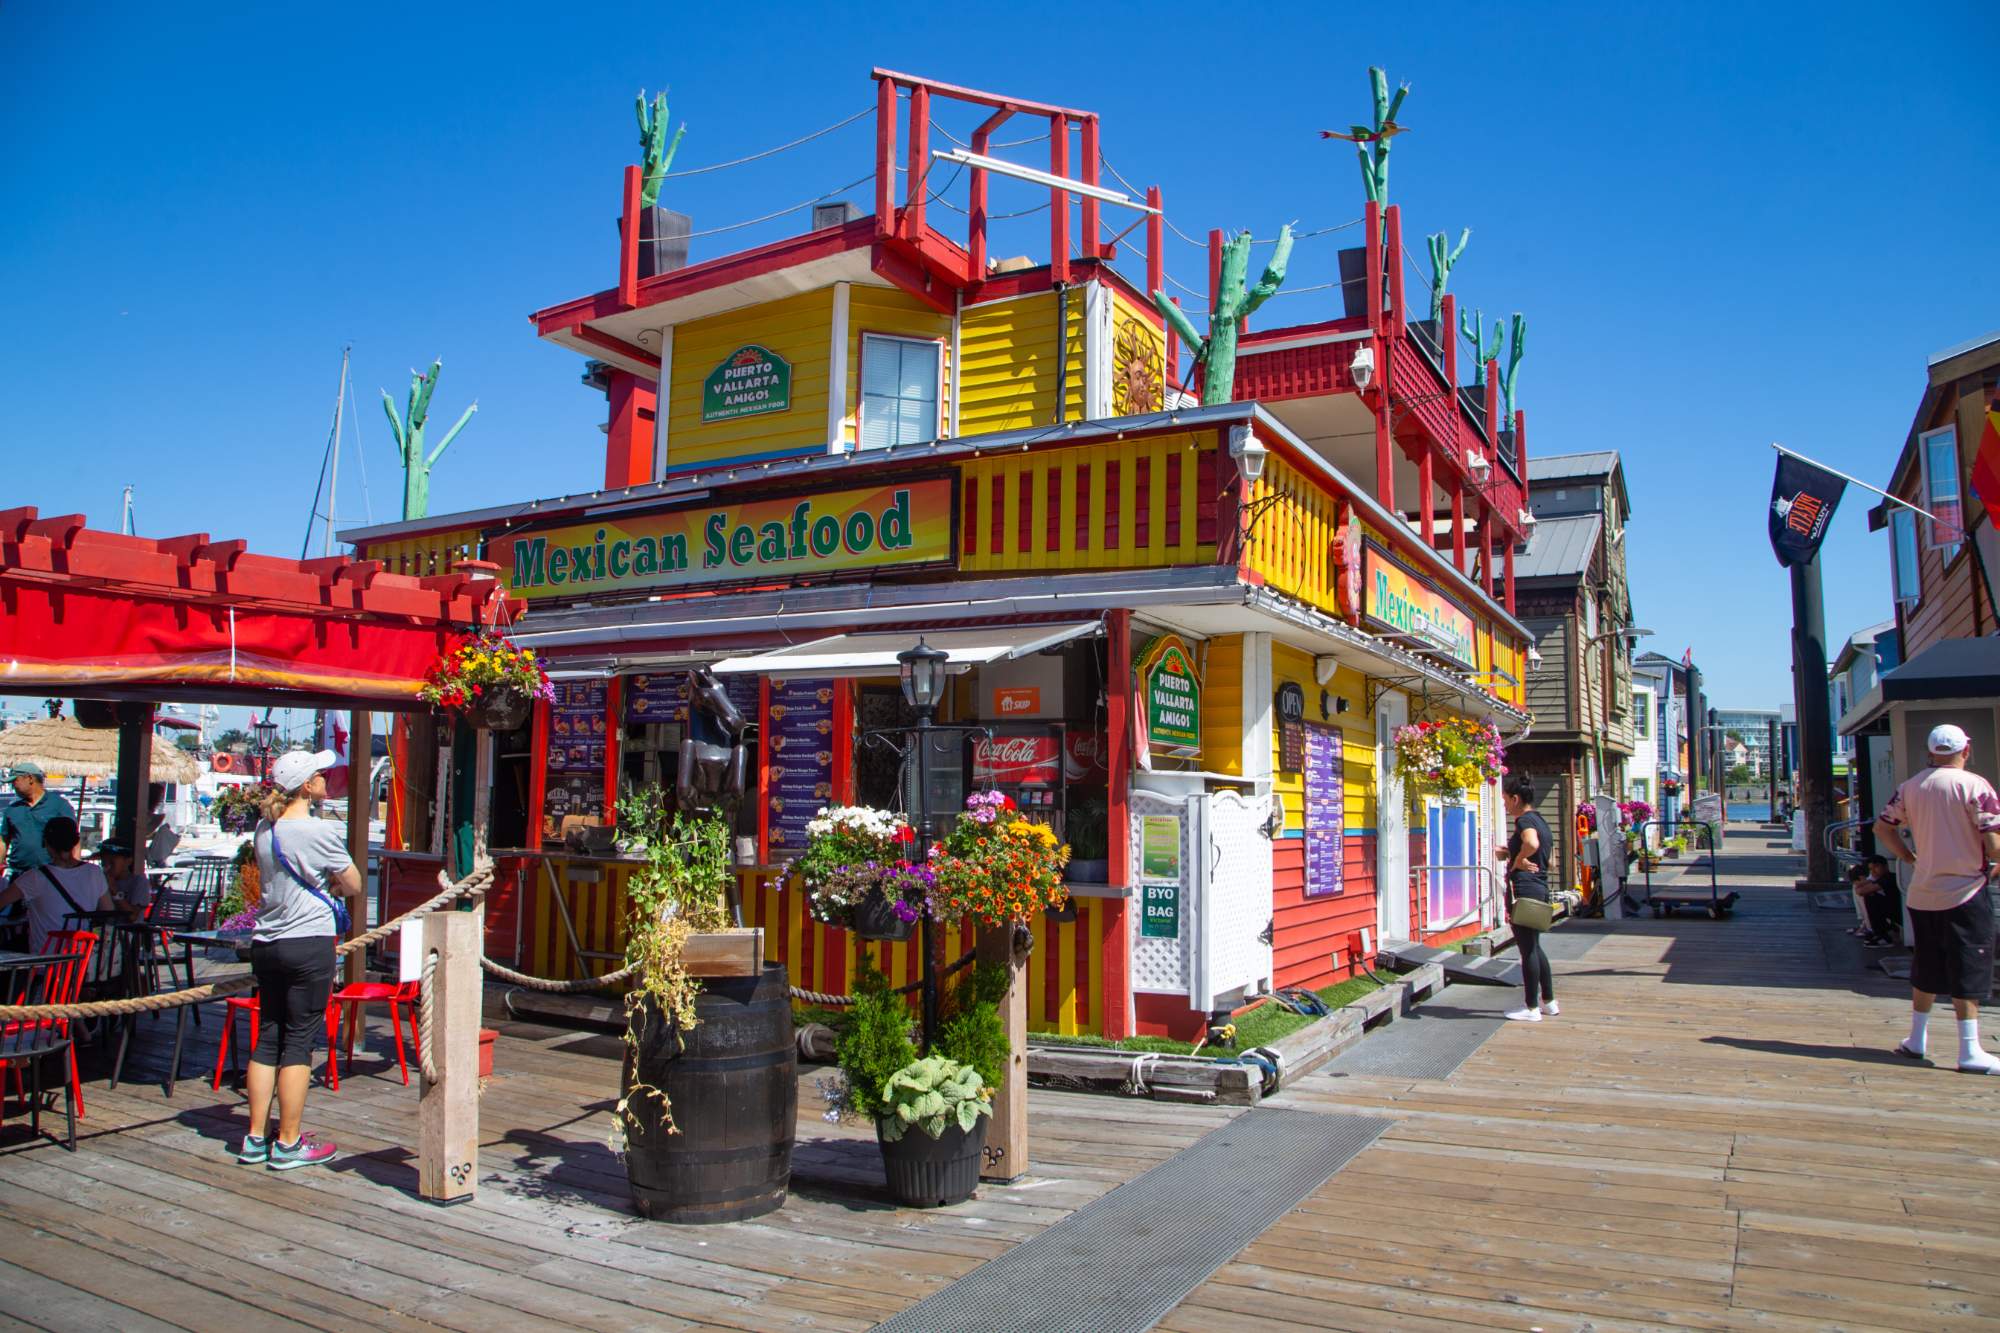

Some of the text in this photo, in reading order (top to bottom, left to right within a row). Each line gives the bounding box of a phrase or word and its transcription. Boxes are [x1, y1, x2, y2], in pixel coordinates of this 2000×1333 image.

[724, 362, 773, 379] PUERTO
[713, 374, 780, 394] VALLARTA
[724, 389, 769, 406] AMIGOS
[512, 488, 914, 588] Mexican Seafood
[1159, 672, 1190, 693] PUERTO
[1013, 700, 1031, 710] SKIP
[1154, 689, 1195, 712] VALLARTA
[1282, 690, 1302, 716] OPEN
[1159, 709, 1190, 728] AMIGOS
[1148, 887, 1174, 900] BYO
[1147, 905, 1174, 918] BAG
